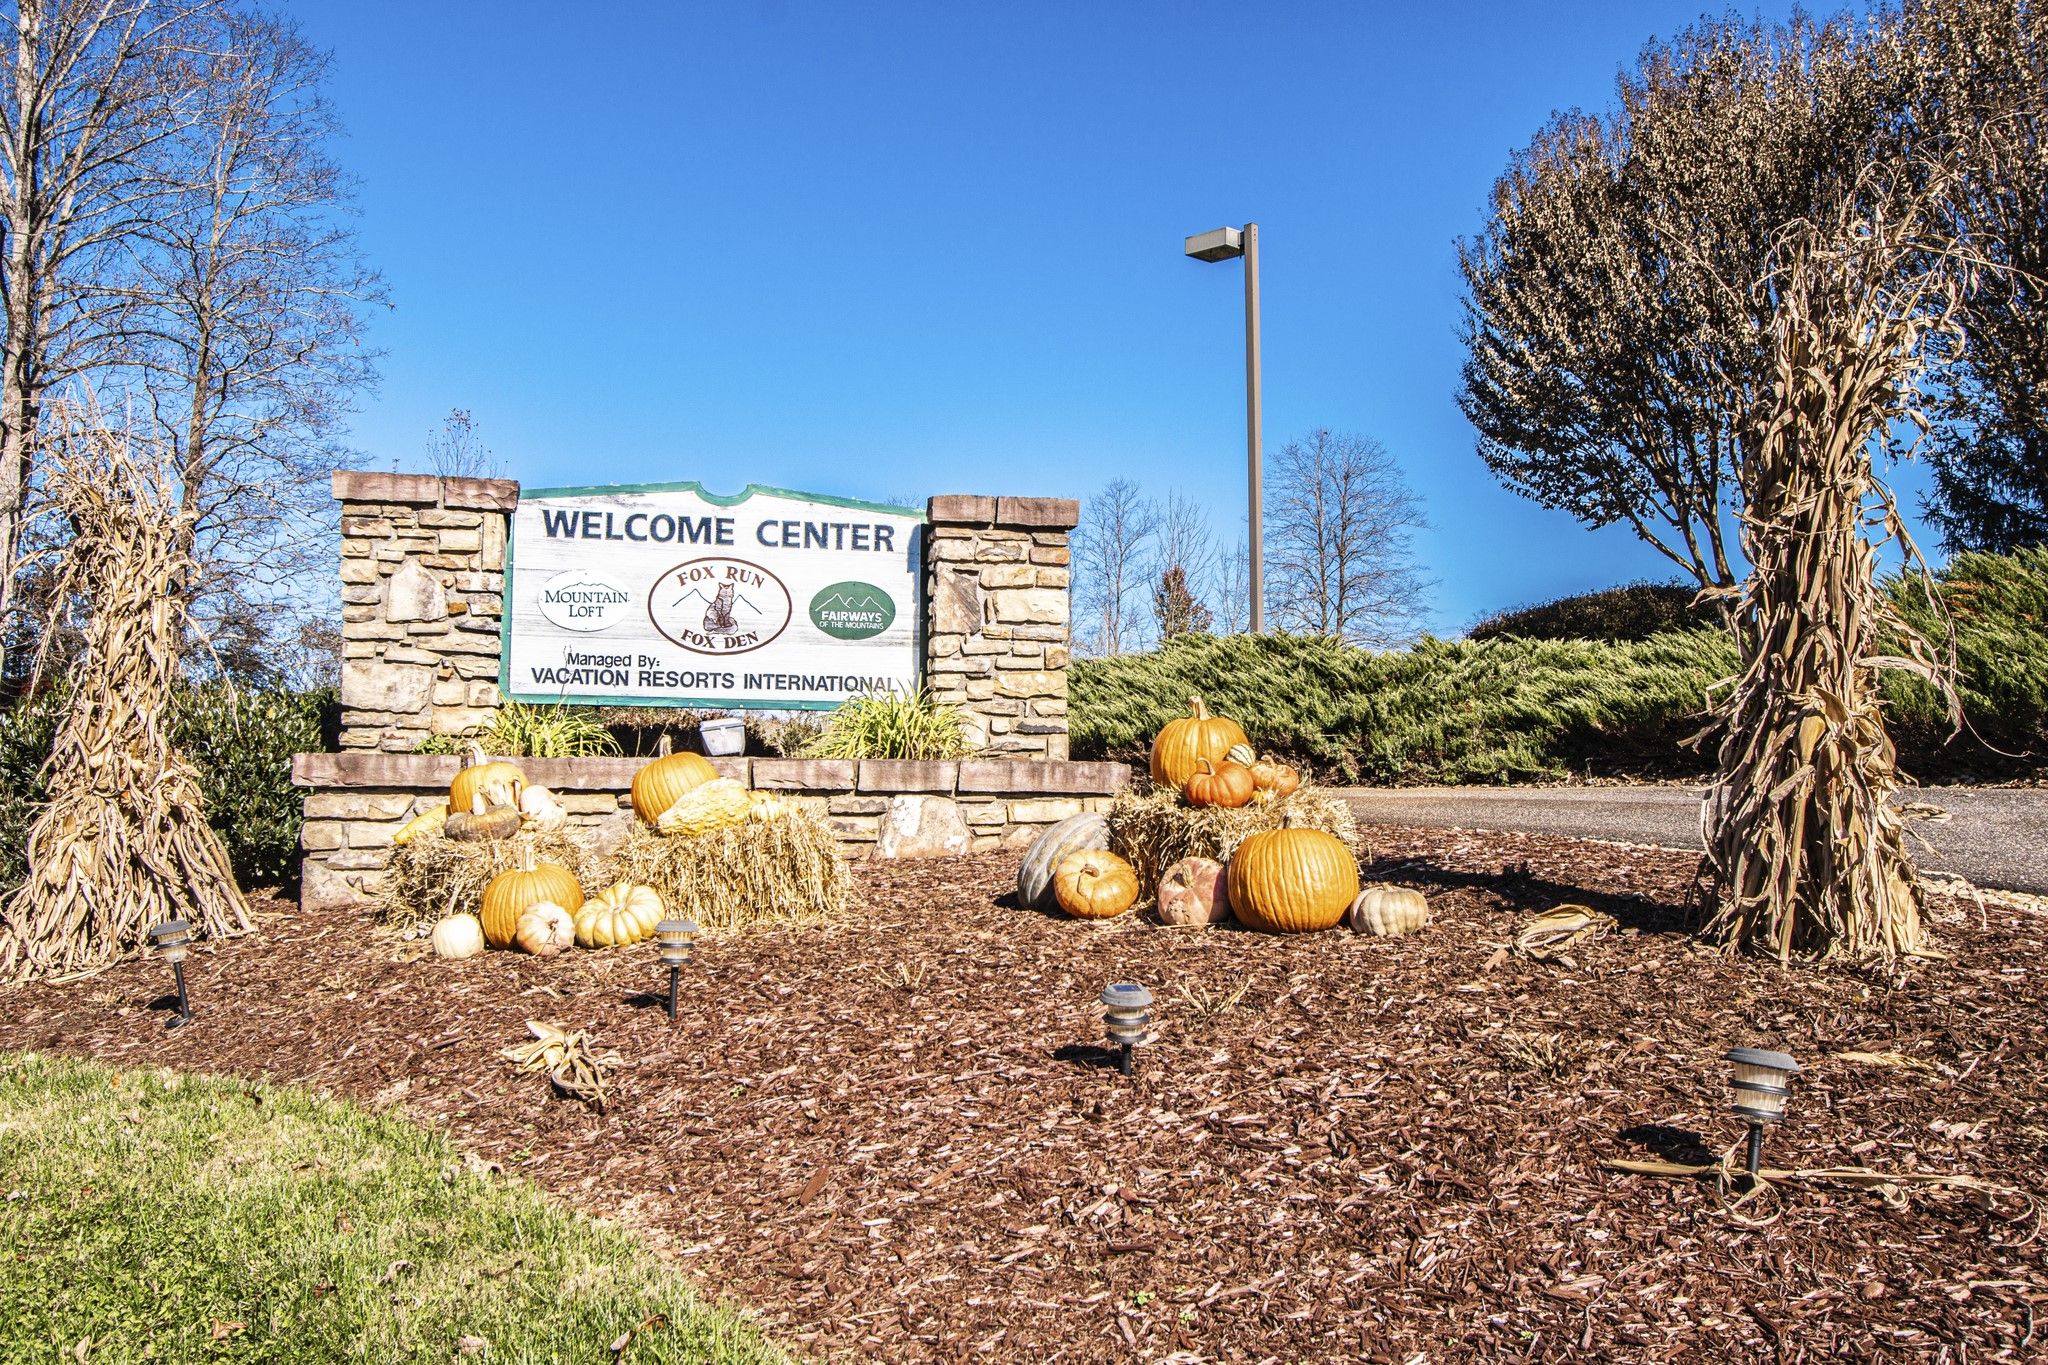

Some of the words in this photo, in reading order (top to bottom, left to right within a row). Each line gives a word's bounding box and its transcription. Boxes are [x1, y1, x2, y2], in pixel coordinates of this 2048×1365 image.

[542, 509, 735, 546] WELCOME
[756, 519, 895, 552] CENTER
[676, 565, 715, 587] FOX
[725, 565, 765, 589] RUN
[544, 589, 628, 604] MOUNTAIN
[568, 604, 605, 618] LOFT
[821, 610, 883, 623] FAIRWAYS
[818, 620, 829, 628] OF
[831, 621, 844, 629] THE
[844, 621, 884, 630] MOUNTAINS
[680, 628, 715, 649] FOX
[723, 630, 759, 649] DEN
[567, 652, 632, 668] Managed
[637, 654, 660, 670] By:
[531, 667, 629, 687] VACATION
[638, 671, 735, 689] RESORTS
[743, 673, 898, 692] INTERNATIONAL
